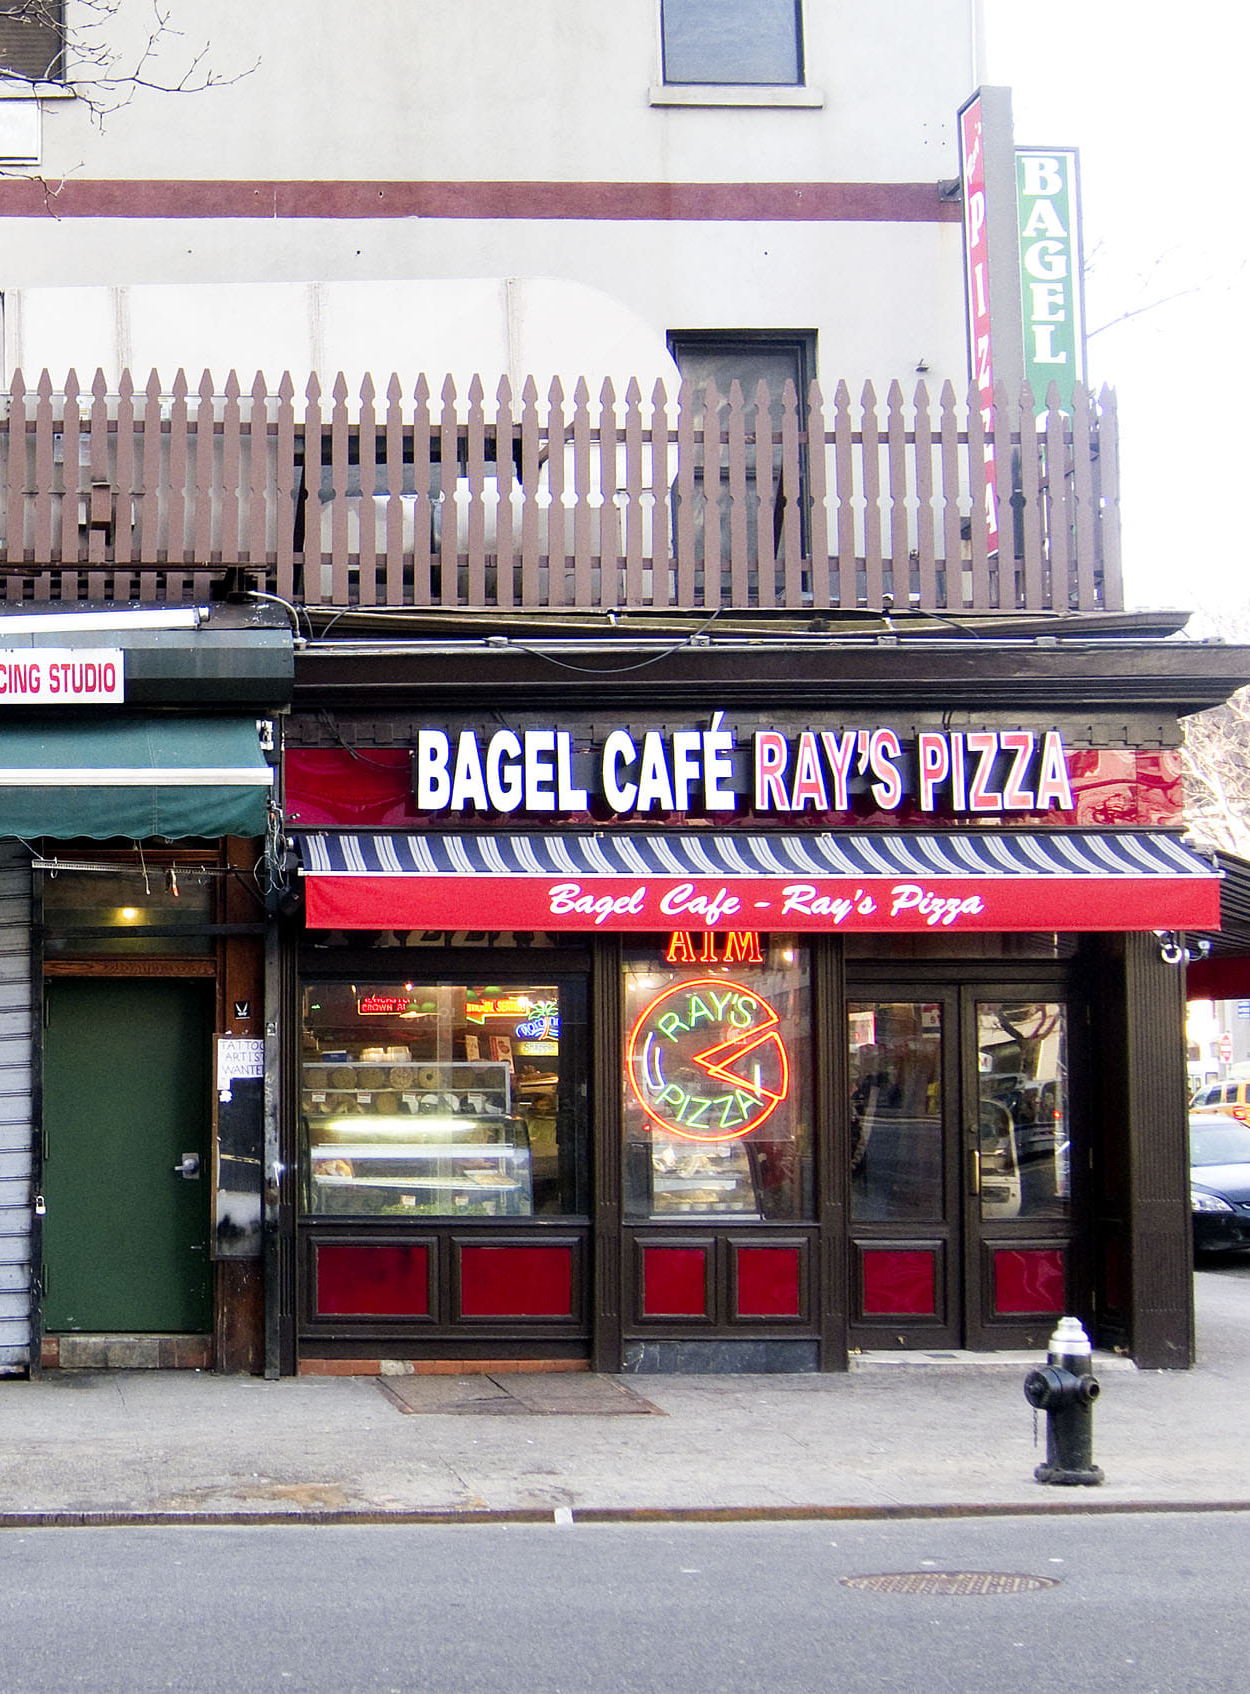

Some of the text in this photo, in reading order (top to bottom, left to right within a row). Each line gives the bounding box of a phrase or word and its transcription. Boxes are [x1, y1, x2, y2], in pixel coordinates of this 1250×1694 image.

[1021, 156, 1068, 364] BAGEL
[49, 662, 116, 694] STUDIO
[417, 710, 1074, 814] BAGEL CAFÉ RAY'S PIZZA
[547, 882, 648, 925] Bagel
[659, 882, 741, 926] Cafe
[781, 884, 878, 926] Ray's
[890, 884, 985, 926] Pizza
[656, 990, 758, 1043] RAY'S
[221, 1064, 264, 1076] WANTE
[654, 1082, 765, 1130] PIZZA
